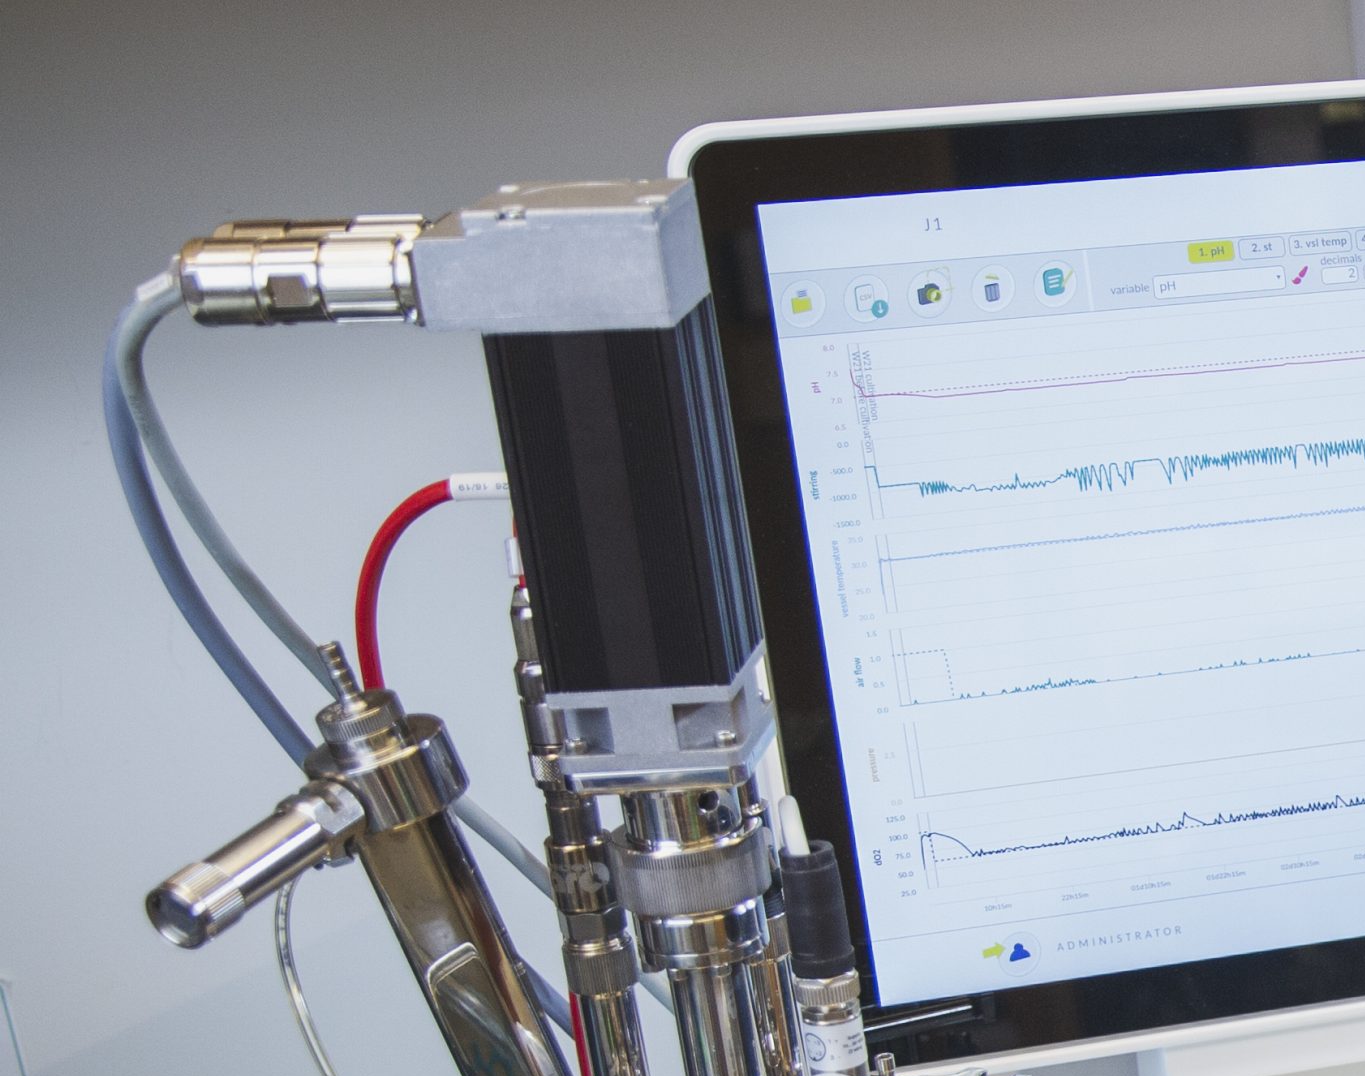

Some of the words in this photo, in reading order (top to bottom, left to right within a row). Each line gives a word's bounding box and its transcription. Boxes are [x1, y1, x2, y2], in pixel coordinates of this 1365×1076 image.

[924, 217, 943, 232] J1
[1251, 242, 1261, 253] 2.
[1263, 242, 1273, 252] st
[1293, 239, 1304, 250] 3.
[1305, 238, 1318, 249] vsl
[1319, 236, 1348, 250] temp
[1210, 246, 1225, 260] pH
[1320, 252, 1362, 266] decimals
[1348, 268, 1356, 279] 2
[1110, 283, 1150, 296] variable
[1159, 281, 1177, 294] pH
[859, 291, 874, 301] CSV
[811, 381, 822, 394] pH
[808, 470, 819, 500] stirring
[832, 540, 846, 593] temperature
[837, 592, 849, 618] vessel
[853, 657, 863, 676] flow
[857, 676, 865, 688] air
[868, 748, 880, 783] pressure
[873, 849, 883, 866] dO2
[1057, 925, 1183, 952] ADMINISTRATOR
